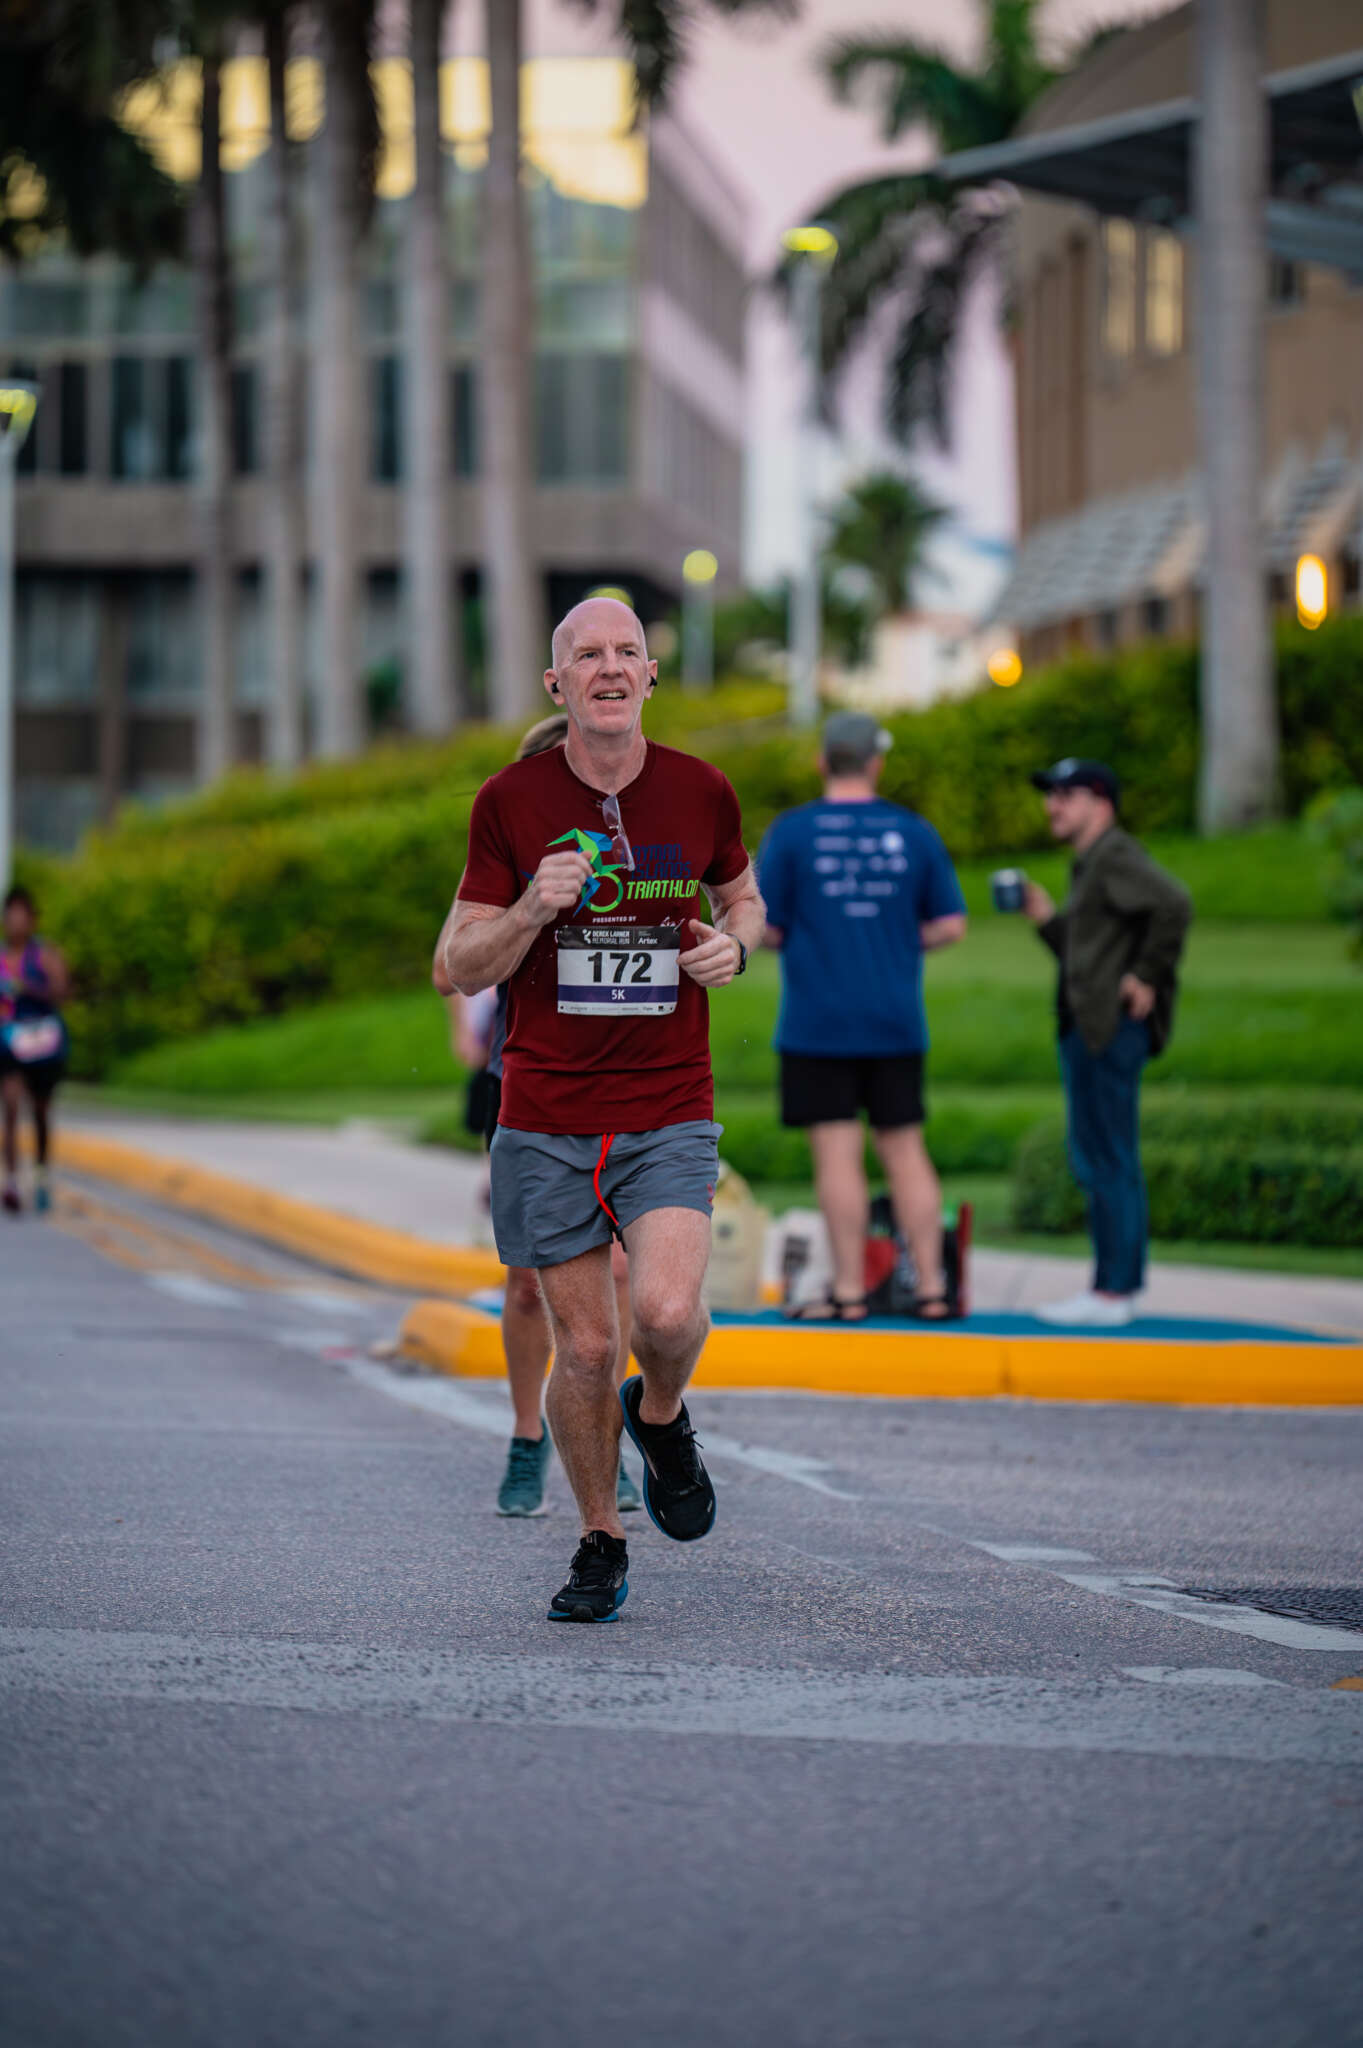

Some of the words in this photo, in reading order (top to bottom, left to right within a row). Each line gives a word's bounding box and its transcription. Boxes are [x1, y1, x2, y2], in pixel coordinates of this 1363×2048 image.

[626, 879, 699, 900] TRIATHLON
[638, 937, 658, 945] Artex
[587, 951, 653, 984] 172
[611, 989, 626, 1001] 5K
